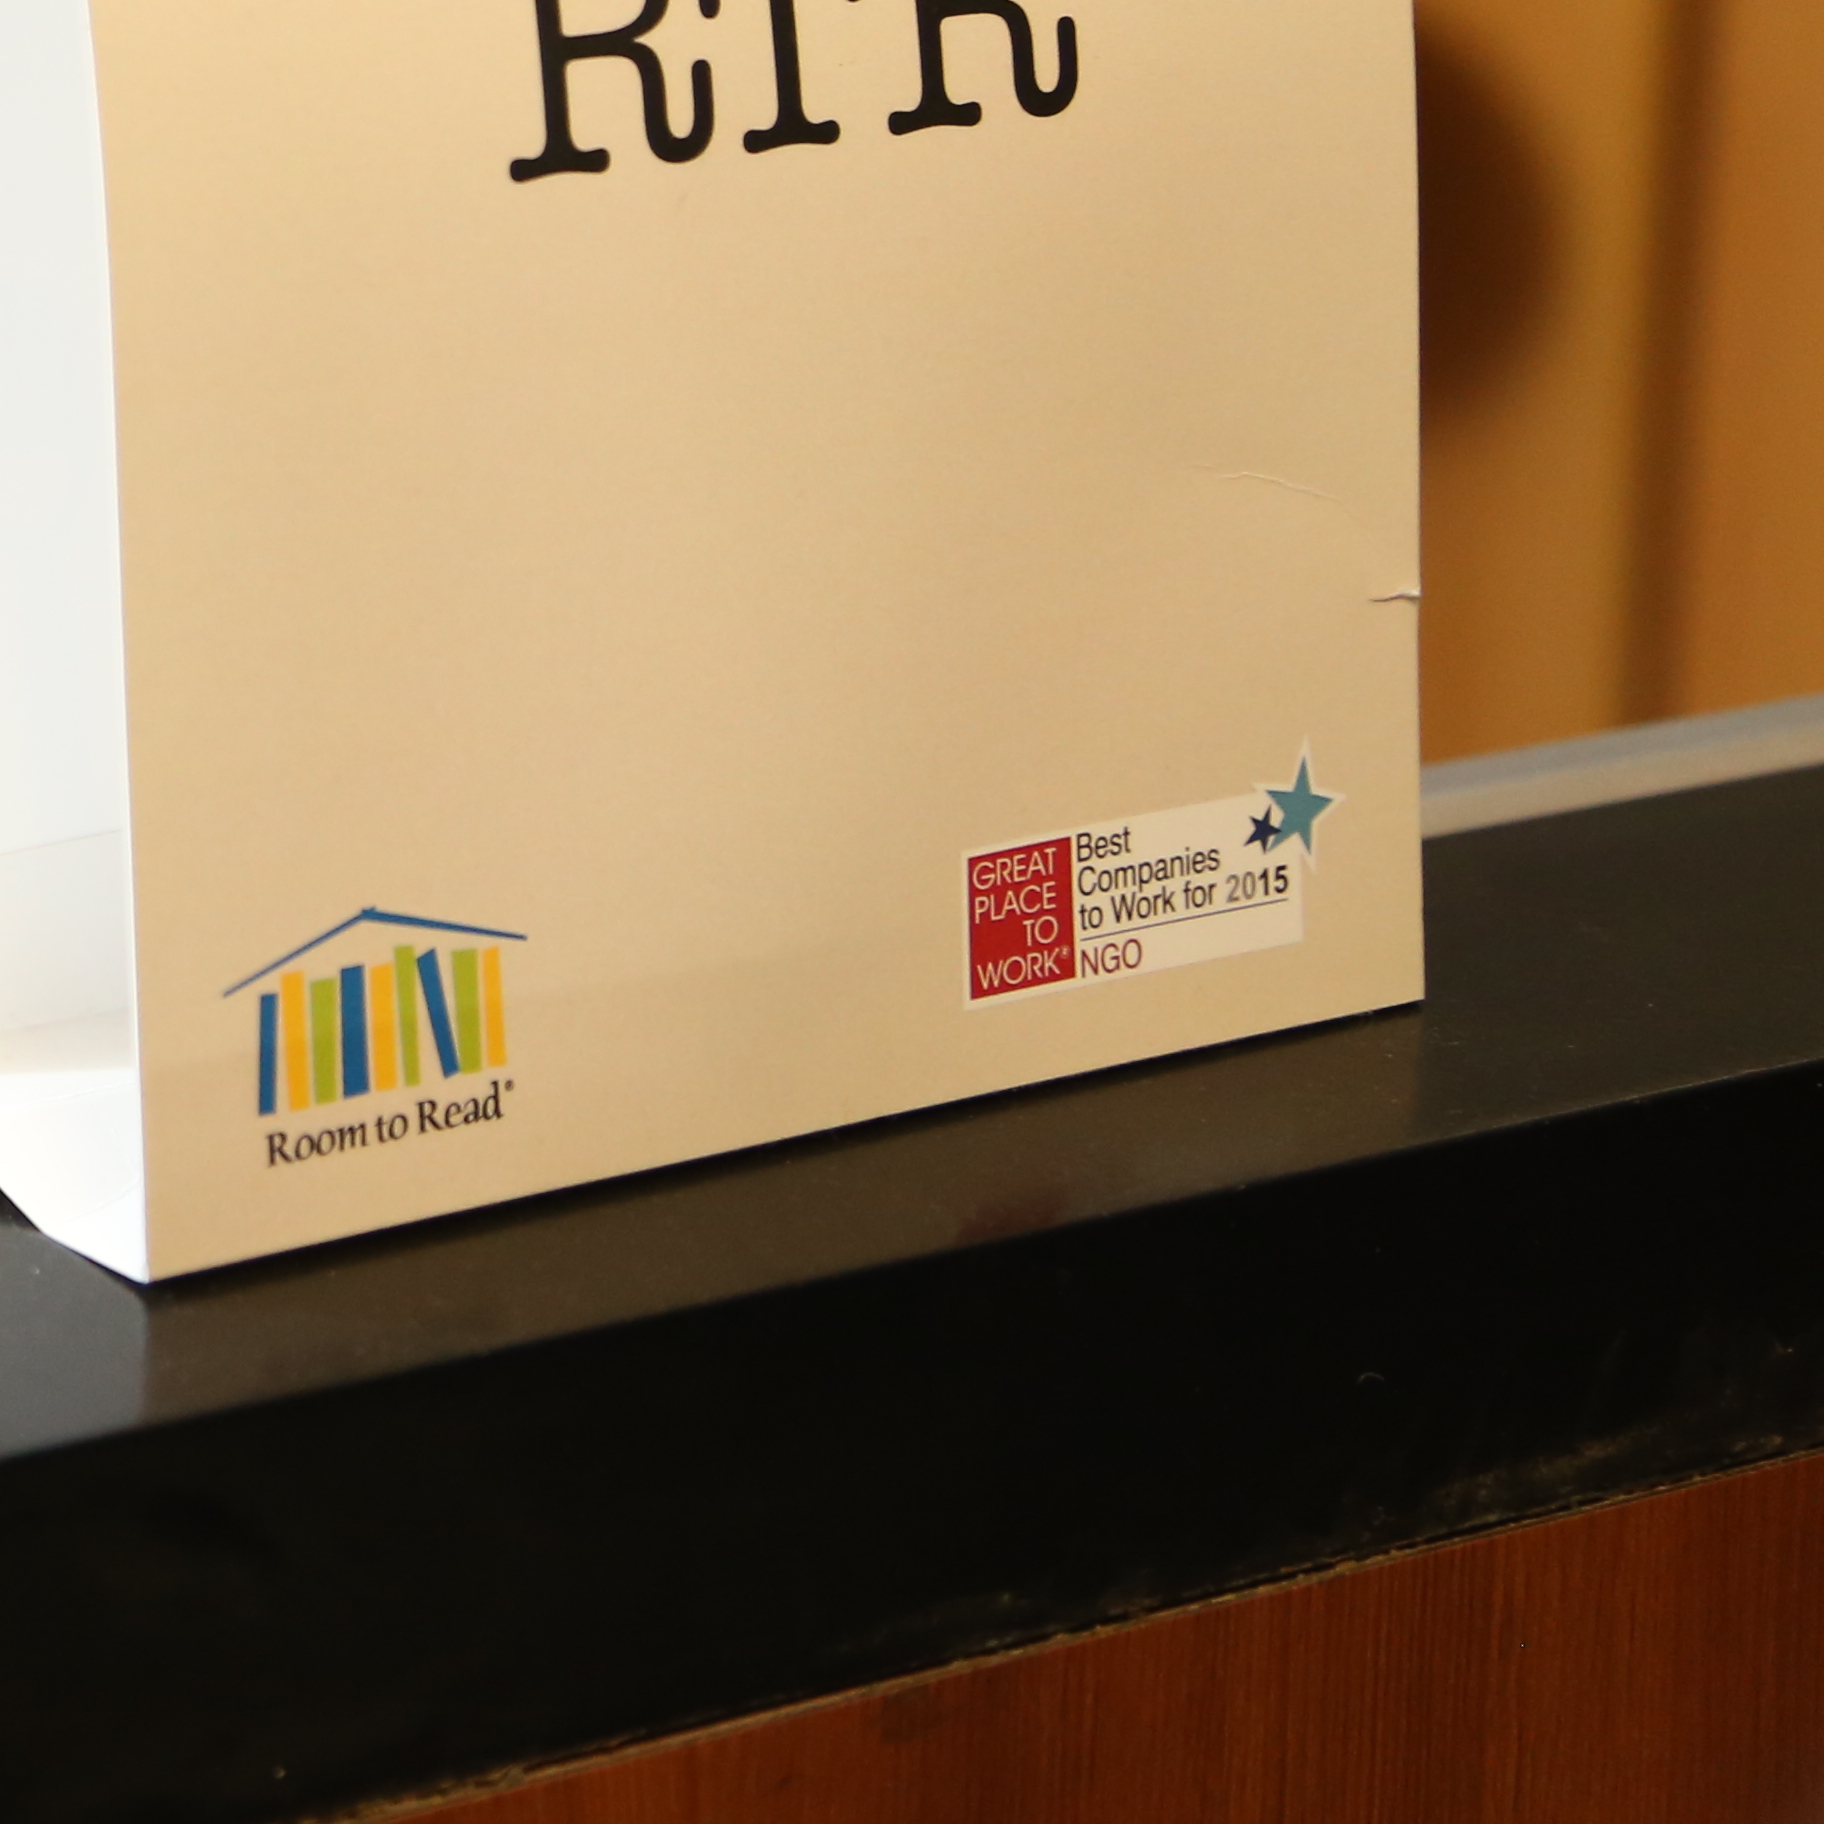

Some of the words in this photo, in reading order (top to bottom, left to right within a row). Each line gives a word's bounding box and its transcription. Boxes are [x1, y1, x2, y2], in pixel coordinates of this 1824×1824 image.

[1076, 826, 1132, 862] Best
[972, 847, 1058, 891] GREAT
[1077, 846, 1221, 897] Companies
[974, 881, 1058, 924] PLACE
[1078, 902, 1104, 931] to
[1110, 889, 1176, 924] Work
[1183, 881, 1217, 909] for
[1225, 864, 1290, 904] 2015
[1022, 916, 1059, 947] TO
[1080, 938, 1143, 979] NGO
[265, 1121, 369, 1168] Room
[373, 1113, 408, 1146] to
